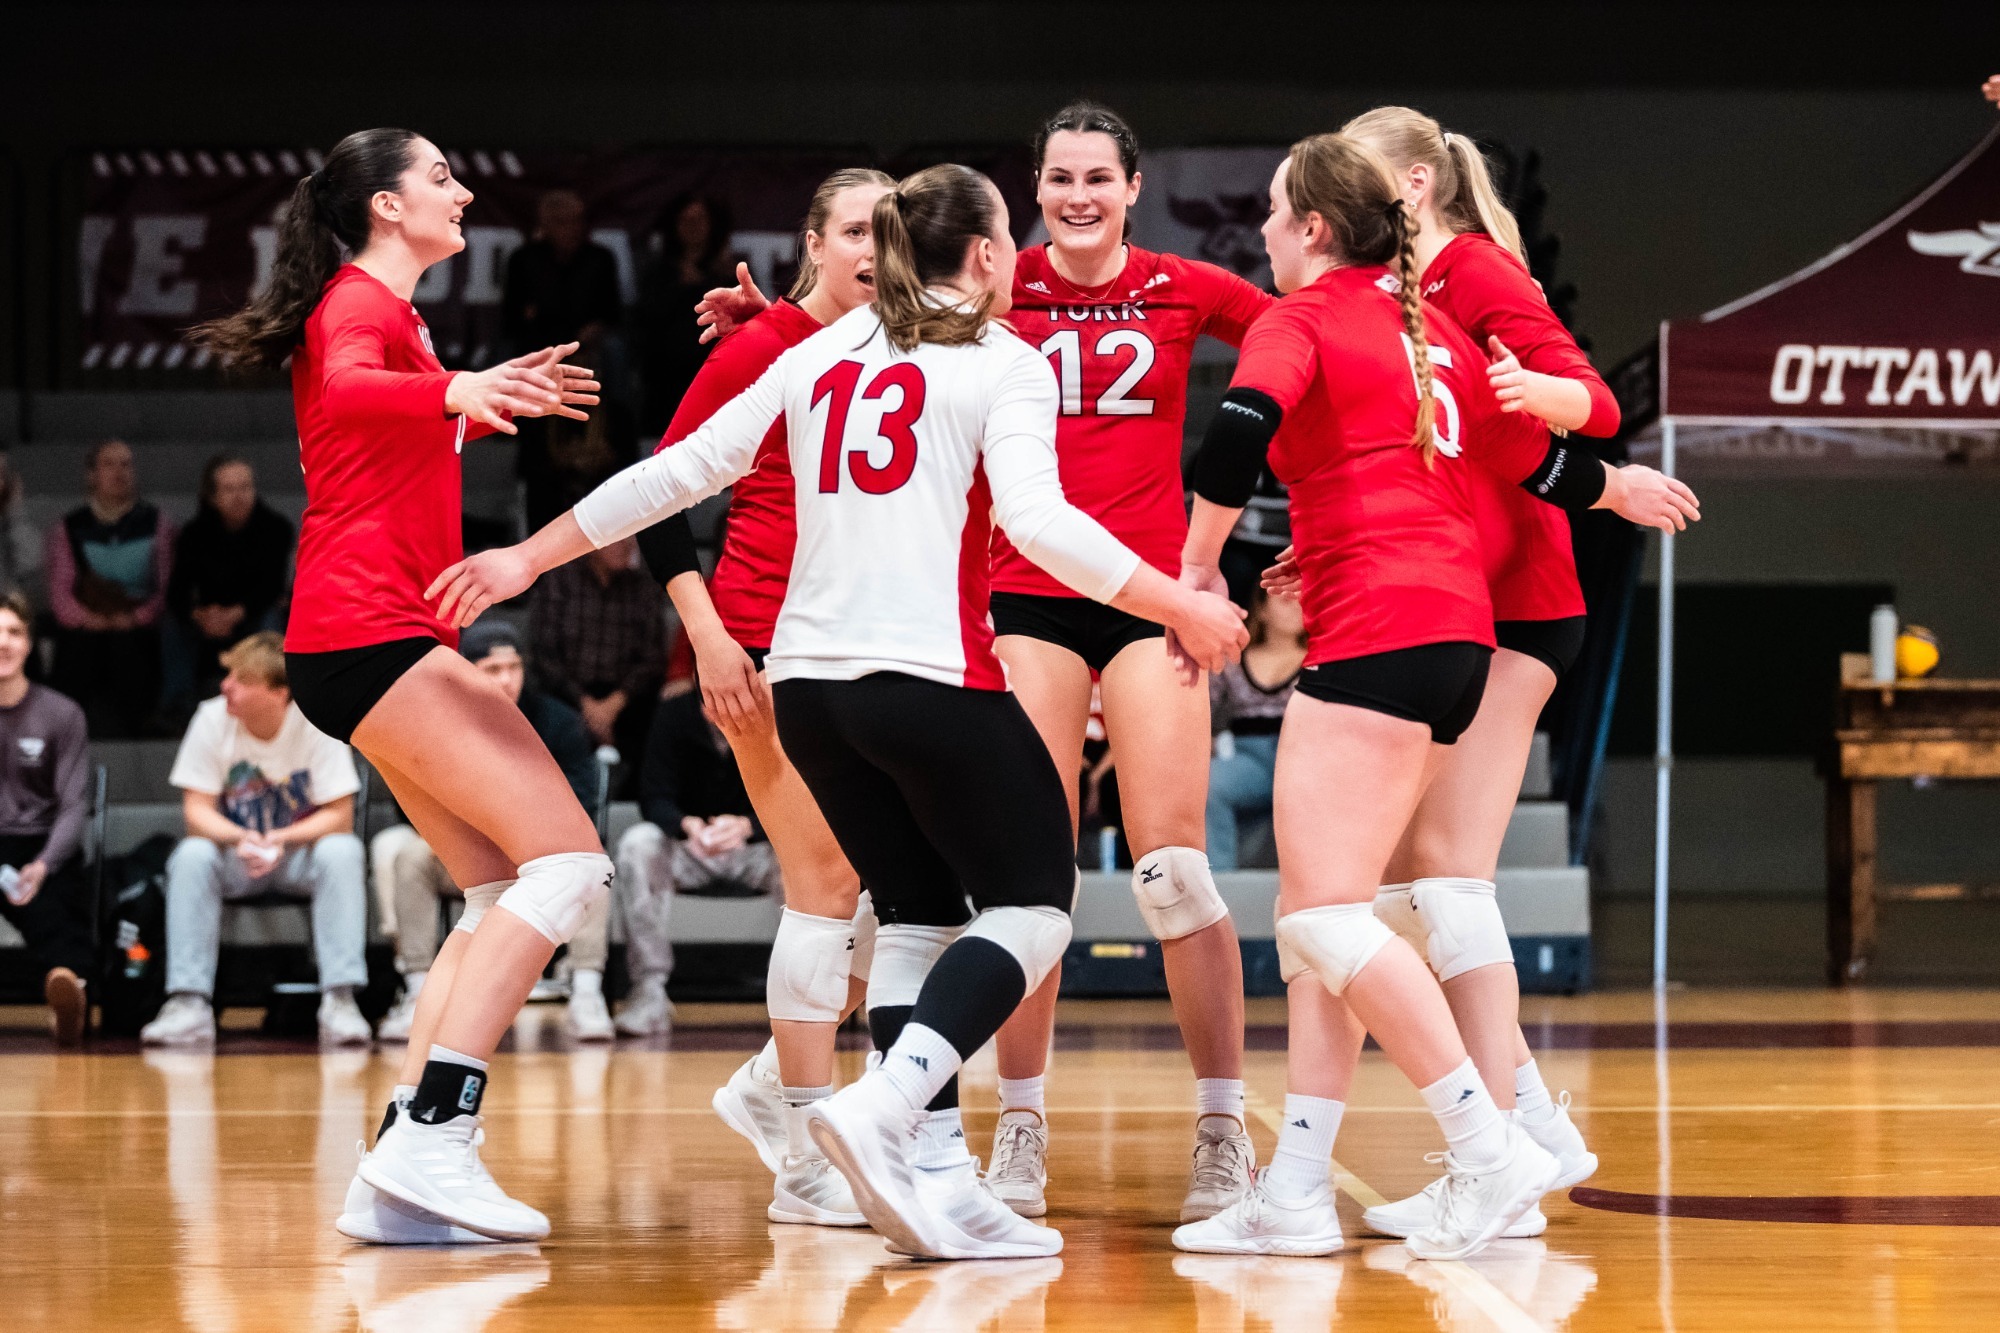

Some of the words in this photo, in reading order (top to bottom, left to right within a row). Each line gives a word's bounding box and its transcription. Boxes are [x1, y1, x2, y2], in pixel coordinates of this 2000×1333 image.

[1040, 329, 1156, 416] 12
[1770, 345, 2000, 406] OTTAW
[810, 359, 927, 496] 13
